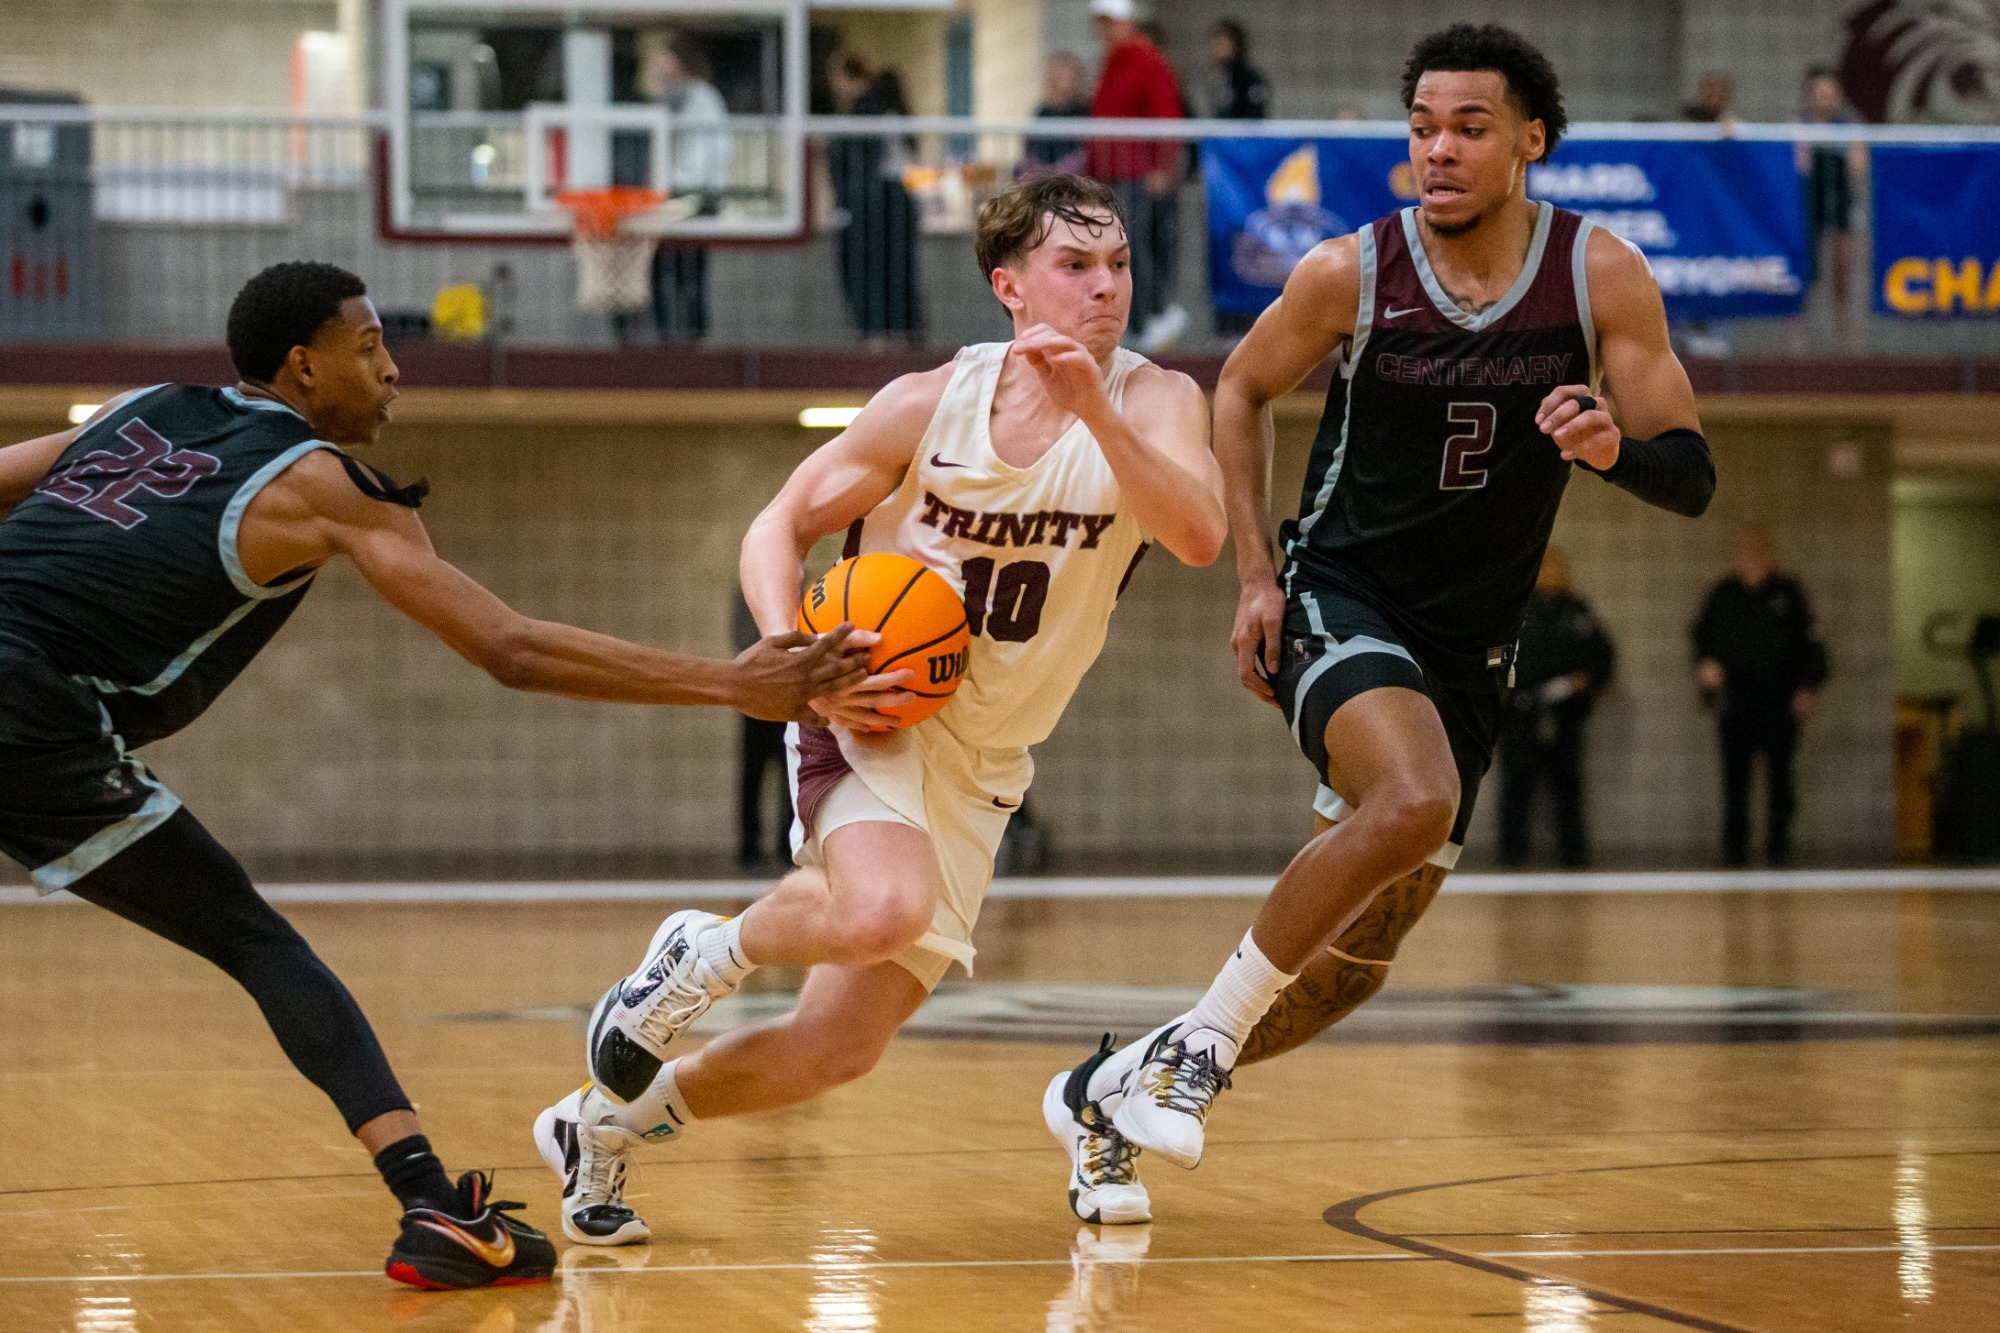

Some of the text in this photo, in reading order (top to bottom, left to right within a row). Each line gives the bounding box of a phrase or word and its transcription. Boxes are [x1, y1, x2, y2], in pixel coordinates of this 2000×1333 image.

[1376, 353, 1573, 386] CENTENARY
[34, 416, 222, 531] 22
[1438, 402, 1497, 490] 2
[920, 490, 1117, 550] TRINITY
[961, 556, 1051, 644] 10
